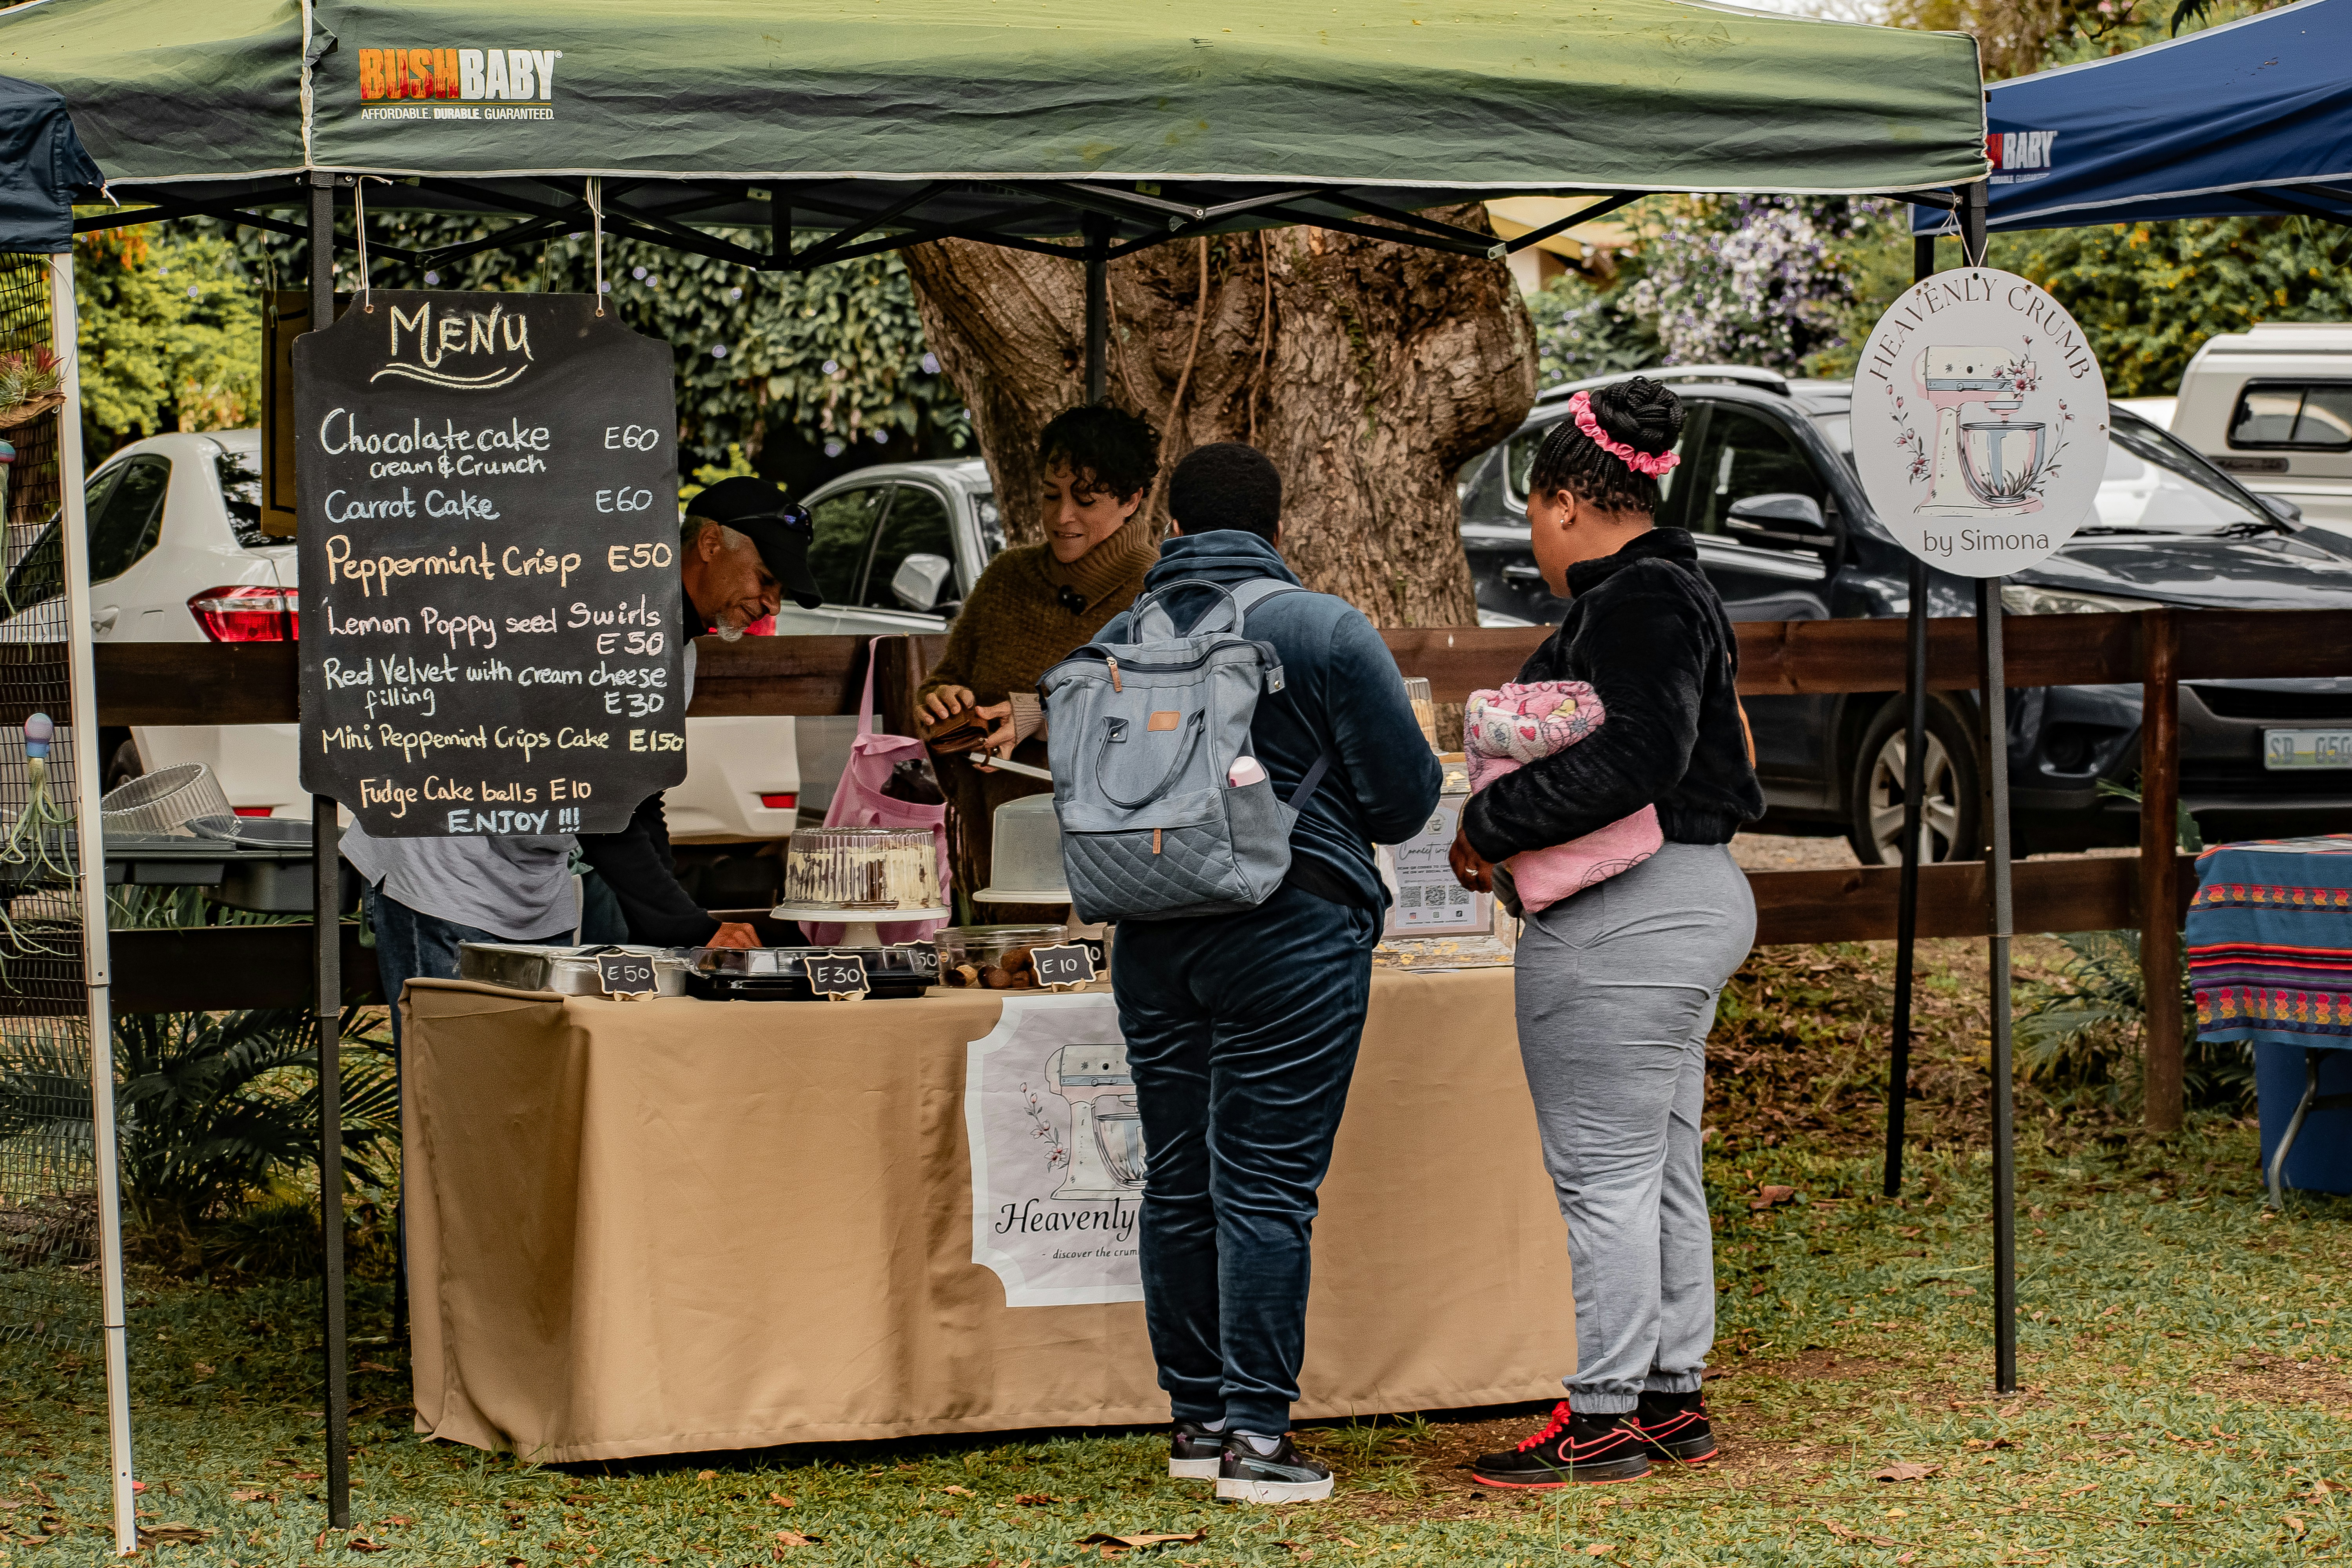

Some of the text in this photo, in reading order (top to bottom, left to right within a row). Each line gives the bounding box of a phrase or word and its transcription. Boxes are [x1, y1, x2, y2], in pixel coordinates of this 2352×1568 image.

[361, 108, 555, 120] AFFORDABLE. DURABLE. GUARANTEED.
[1869, 278, 2090, 381] HEAVENLY CRUMB
[320, 408, 659, 456] Chocolate cake E60
[370, 461, 432, 478] cream
[457, 455, 546, 475] Crunch
[325, 486, 652, 523] Carrot Cake E60
[1924, 529, 2049, 557] by Simona
[325, 535, 673, 597] Peppermint Crisp E50
[328, 594, 661, 649] Lemon Poppy seed Swirls
[323, 653, 667, 690] Red Velvet with cream cheese
[365, 687, 435, 719] filling
[322, 724, 373, 753] Mini
[495, 726, 550, 762] Crips
[557, 727, 609, 748] Cake
[630, 729, 684, 751] E150
[360, 779, 417, 818] Fudge
[424, 776, 474, 801] Cake
[482, 781, 537, 803] balls
[448, 810, 548, 834] ENJOY
[918, 952, 937, 966] 50
[995, 1197, 1135, 1242] Heavenly
[1053, 1248, 1093, 1259] discover
[1096, 1246, 1111, 1257] the
[1114, 1249, 1137, 1257] crum
